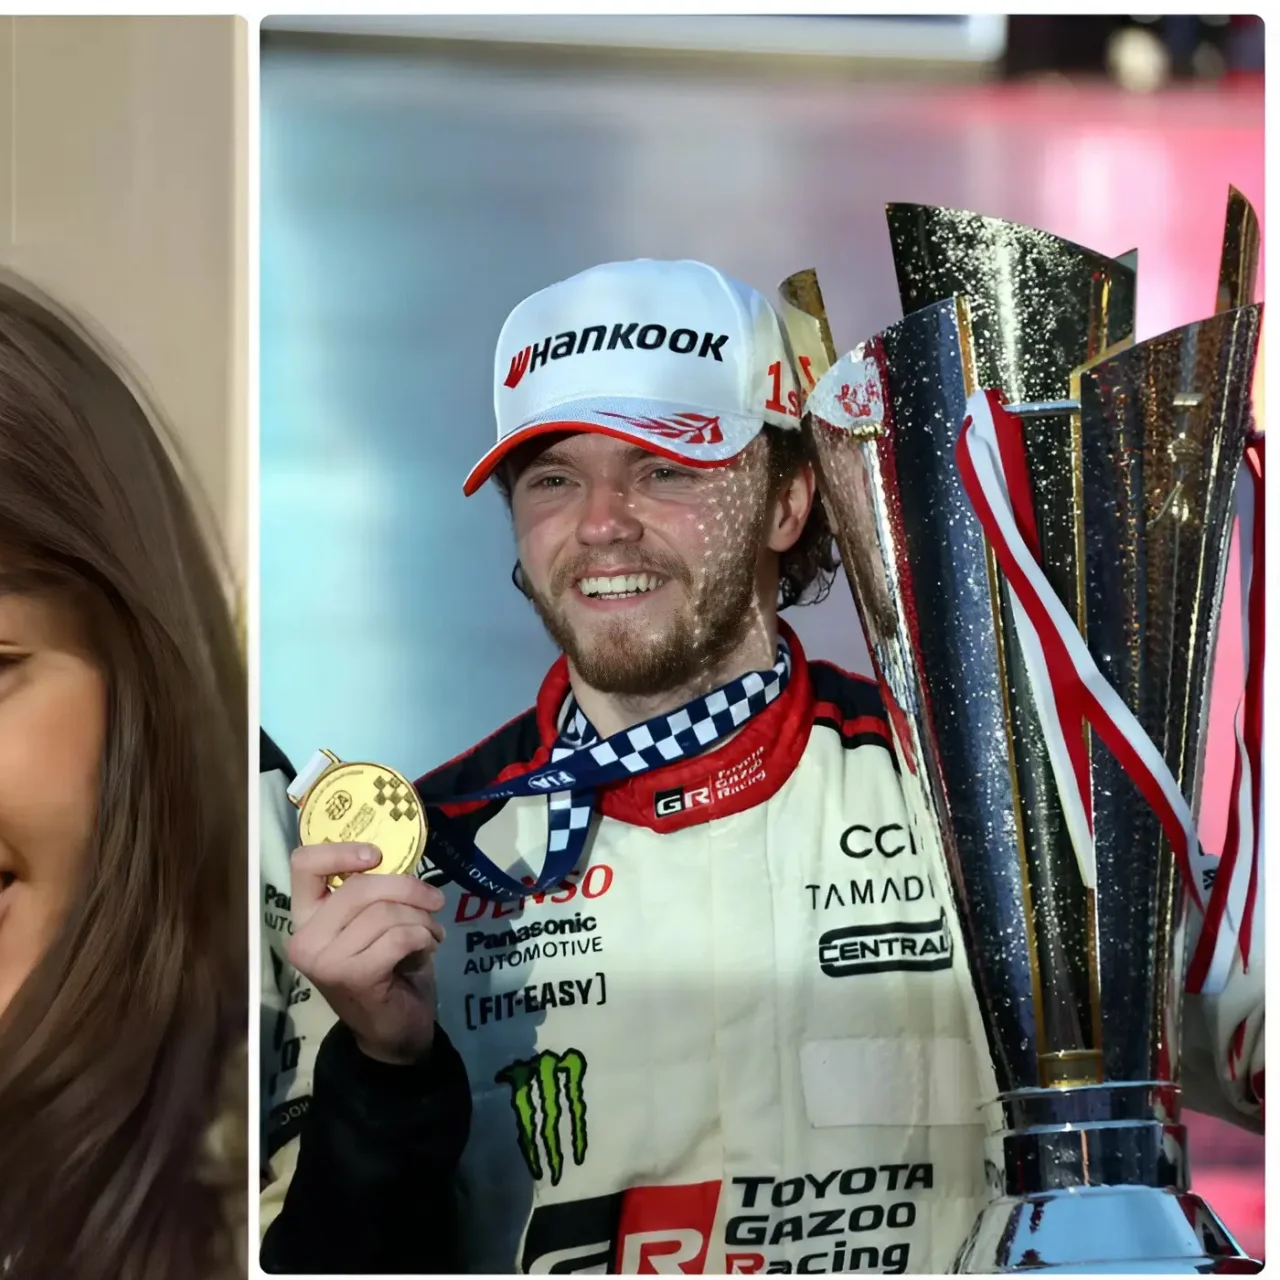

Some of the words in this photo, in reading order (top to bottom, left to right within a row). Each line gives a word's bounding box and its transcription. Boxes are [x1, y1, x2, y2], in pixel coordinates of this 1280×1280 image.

[765, 361, 802, 418] 1s
[656, 787, 710, 815] GR
[465, 912, 597, 953] Panasonic
[819, 935, 949, 964] CENTRAL
[463, 936, 603, 976] AUTOMOTIVE
[731, 1162, 934, 1209] TOYOTA
[724, 1201, 917, 1247] GAZOO
[725, 1240, 911, 1275] Racing
